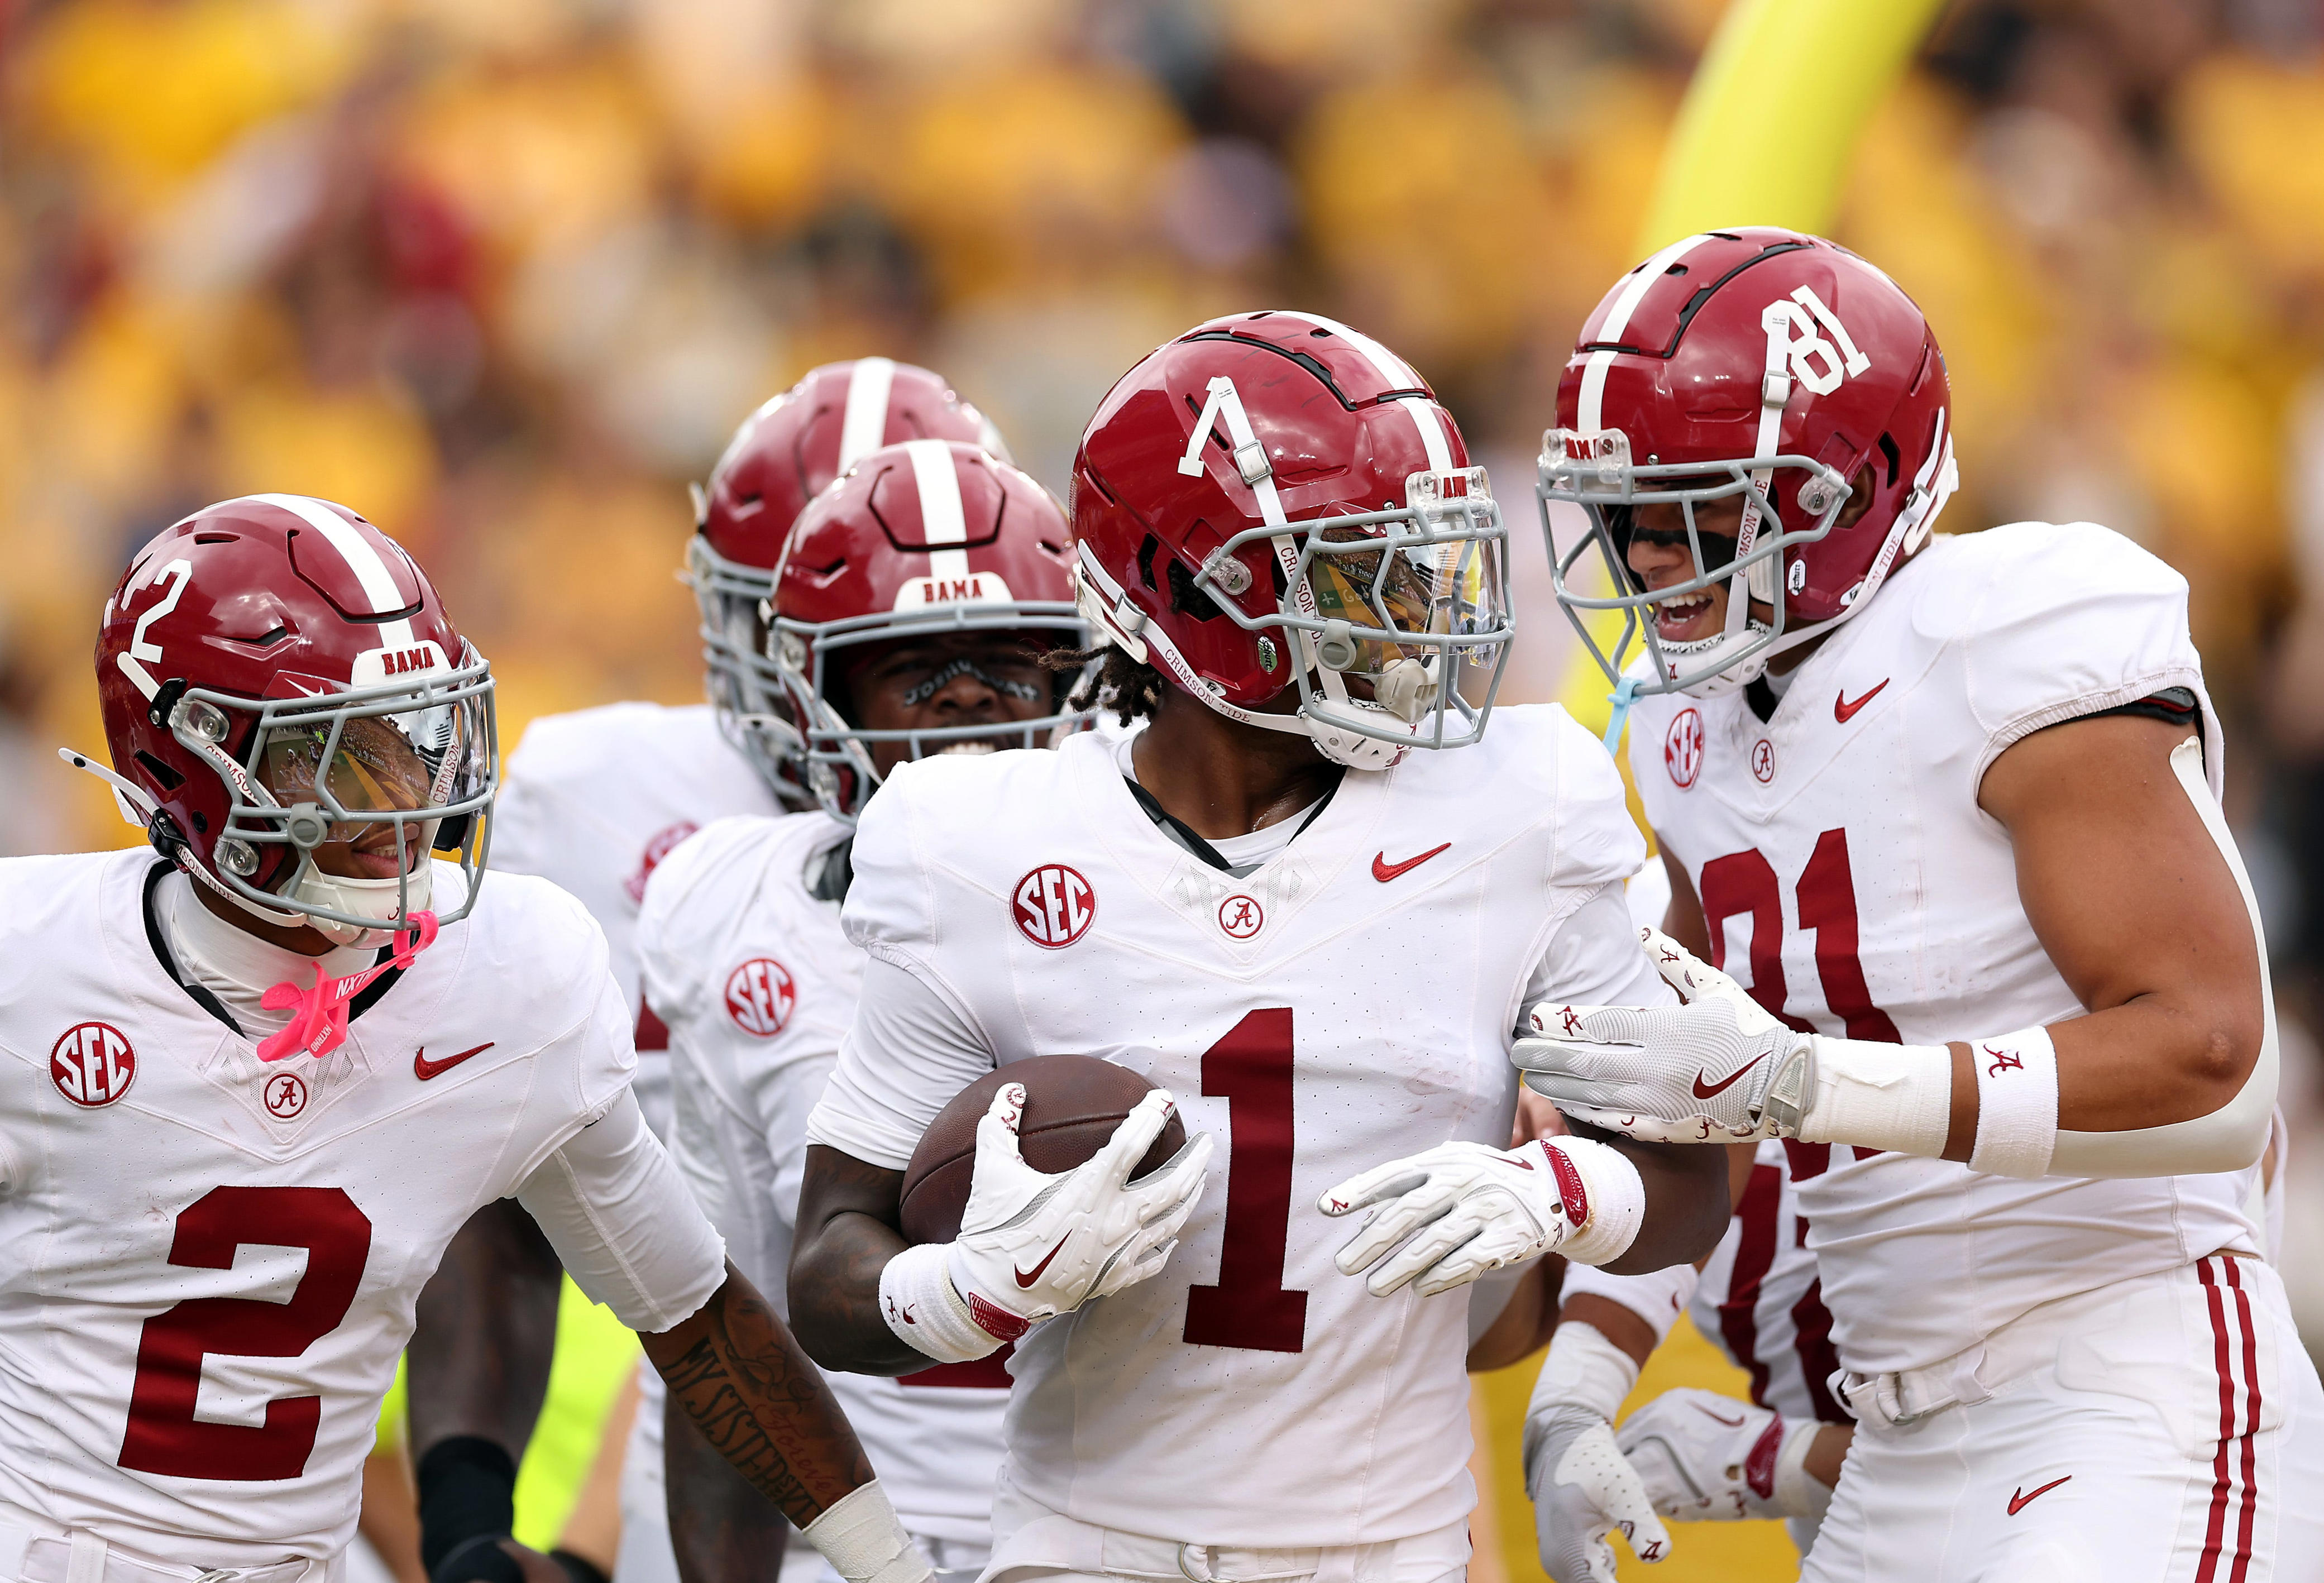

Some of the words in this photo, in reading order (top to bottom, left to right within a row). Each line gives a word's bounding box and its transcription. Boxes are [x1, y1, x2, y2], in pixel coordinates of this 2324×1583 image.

[1761, 284, 1871, 396] 81
[1177, 377, 1223, 477] 1
[130, 558, 193, 664] 2
[923, 579, 983, 603] BAMA
[1280, 547, 1314, 614] CRISON
[381, 647, 435, 675] BAMA
[1165, 648, 1214, 705] CRIMSON
[1219, 702, 1252, 723] TIDE
[1667, 711, 1701, 783] SEC
[1756, 746, 1771, 774] A
[206, 876, 234, 902] TIDE
[1017, 868, 1092, 943] SEC
[1226, 902, 1254, 930] A
[728, 959, 795, 1033] SEC
[55, 1026, 130, 1102] SEC
[270, 1080, 297, 1109] A
[1182, 1007, 1309, 1352] 1
[117, 1185, 373, 1481] 2
